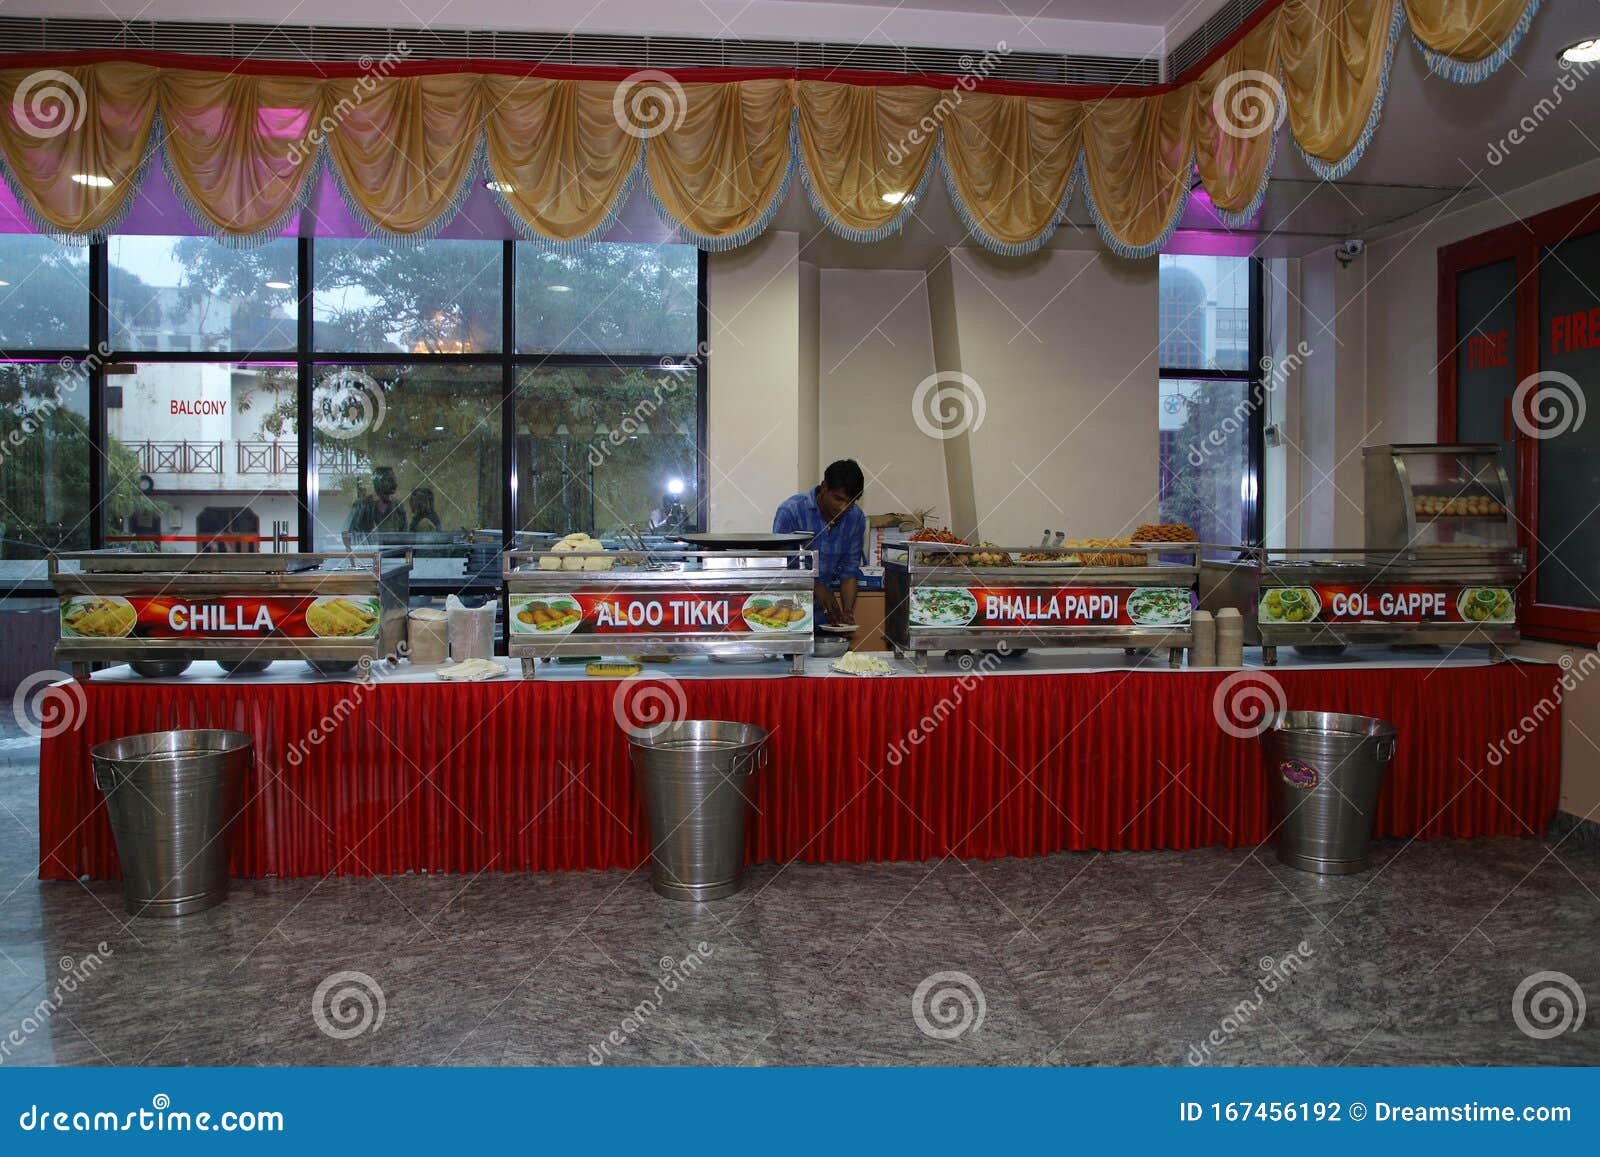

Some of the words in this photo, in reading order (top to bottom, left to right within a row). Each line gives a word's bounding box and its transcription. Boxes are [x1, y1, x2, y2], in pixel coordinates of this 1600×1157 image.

[1551, 308, 1600, 355] FIRE
[1467, 331, 1509, 372] FIRE
[170, 399, 227, 415] BALCONY
[168, 604, 275, 631] CHILLA
[596, 600, 664, 627] ALOO
[669, 600, 729, 625] TIKKI
[986, 595, 1061, 620] BHALLA
[1065, 595, 1119, 620] PAPDI
[1332, 592, 1375, 616] GOL
[1379, 592, 1447, 616] GAPPE
